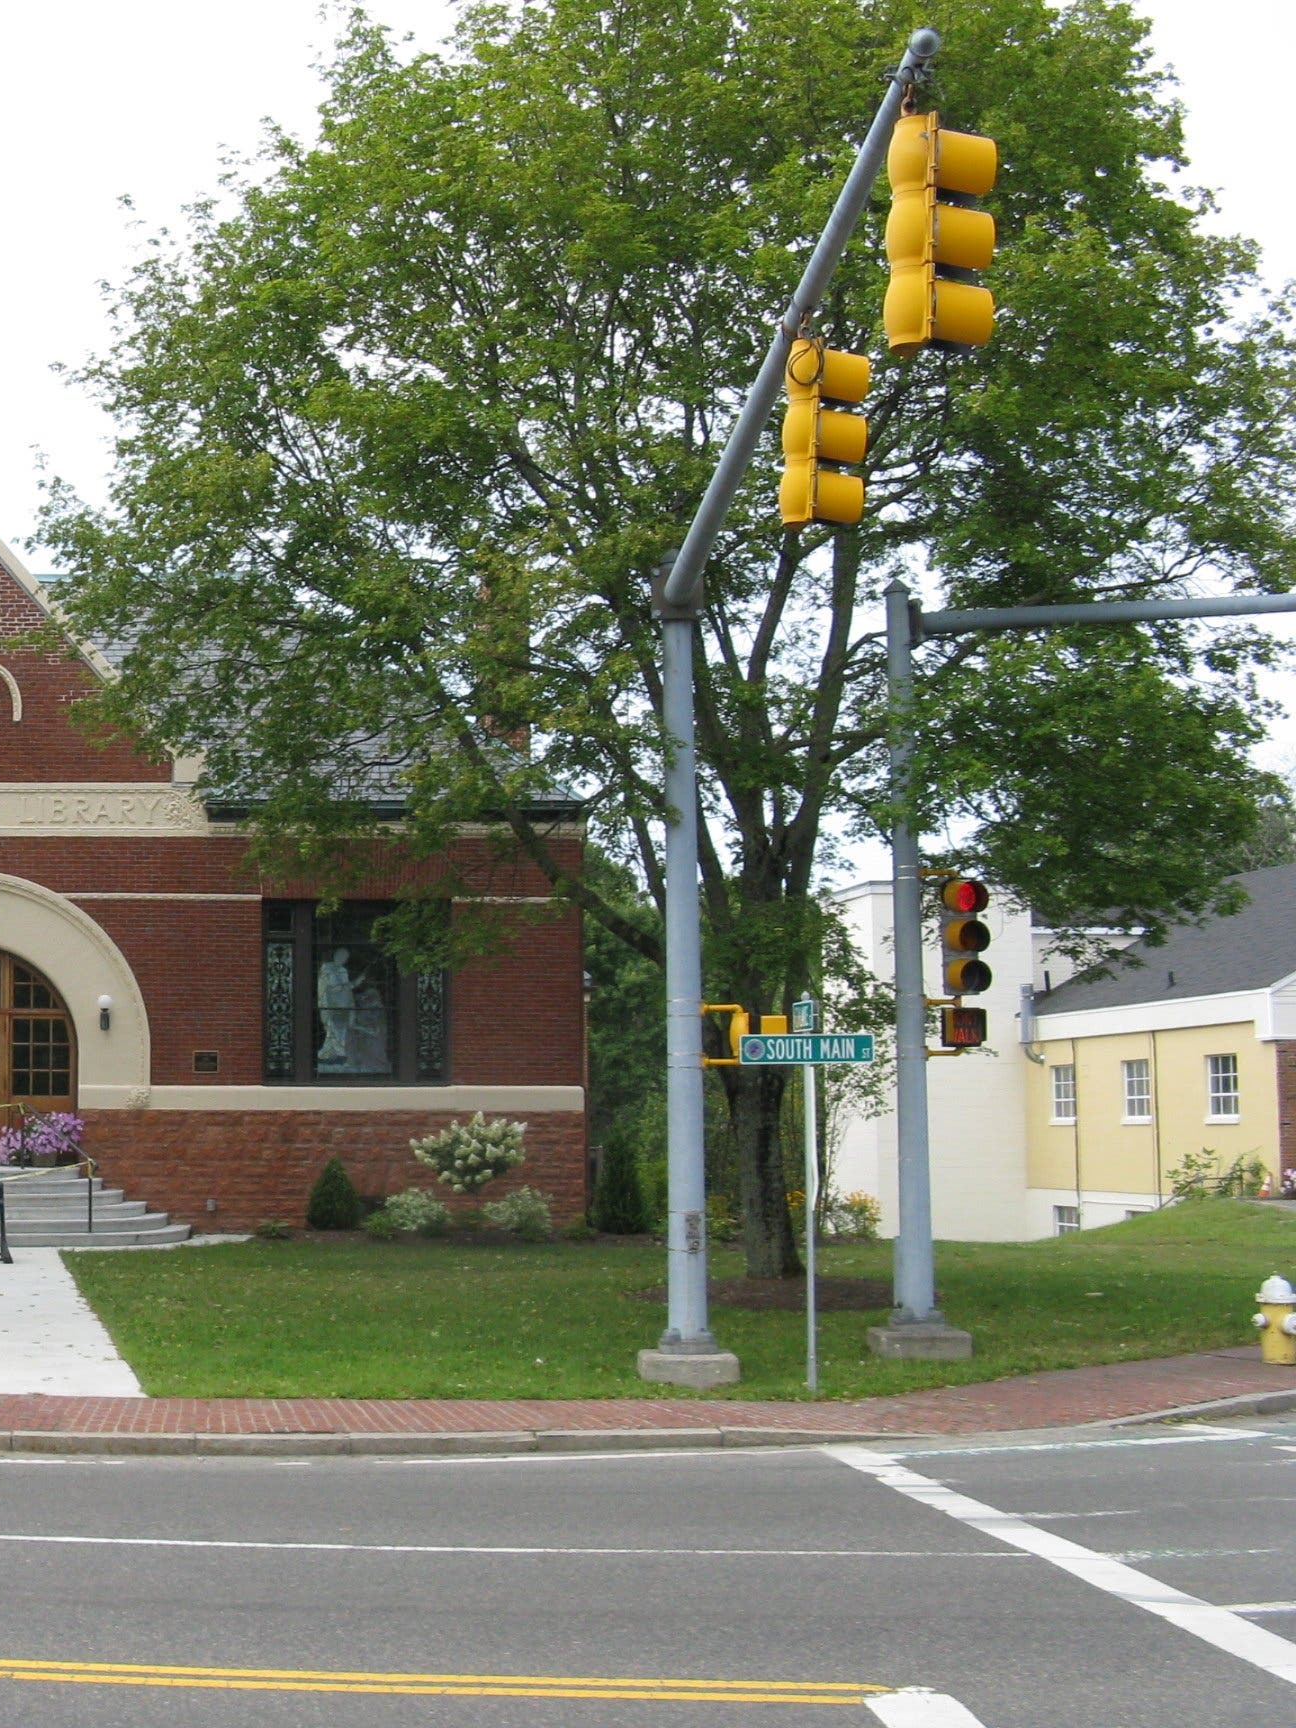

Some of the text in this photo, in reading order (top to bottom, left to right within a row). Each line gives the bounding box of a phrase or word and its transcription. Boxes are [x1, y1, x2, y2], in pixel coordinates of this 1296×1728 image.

[19, 796, 161, 825] LIBRARY
[766, 1038, 812, 1060] SOUTH
[820, 1037, 855, 1059] MAIN
